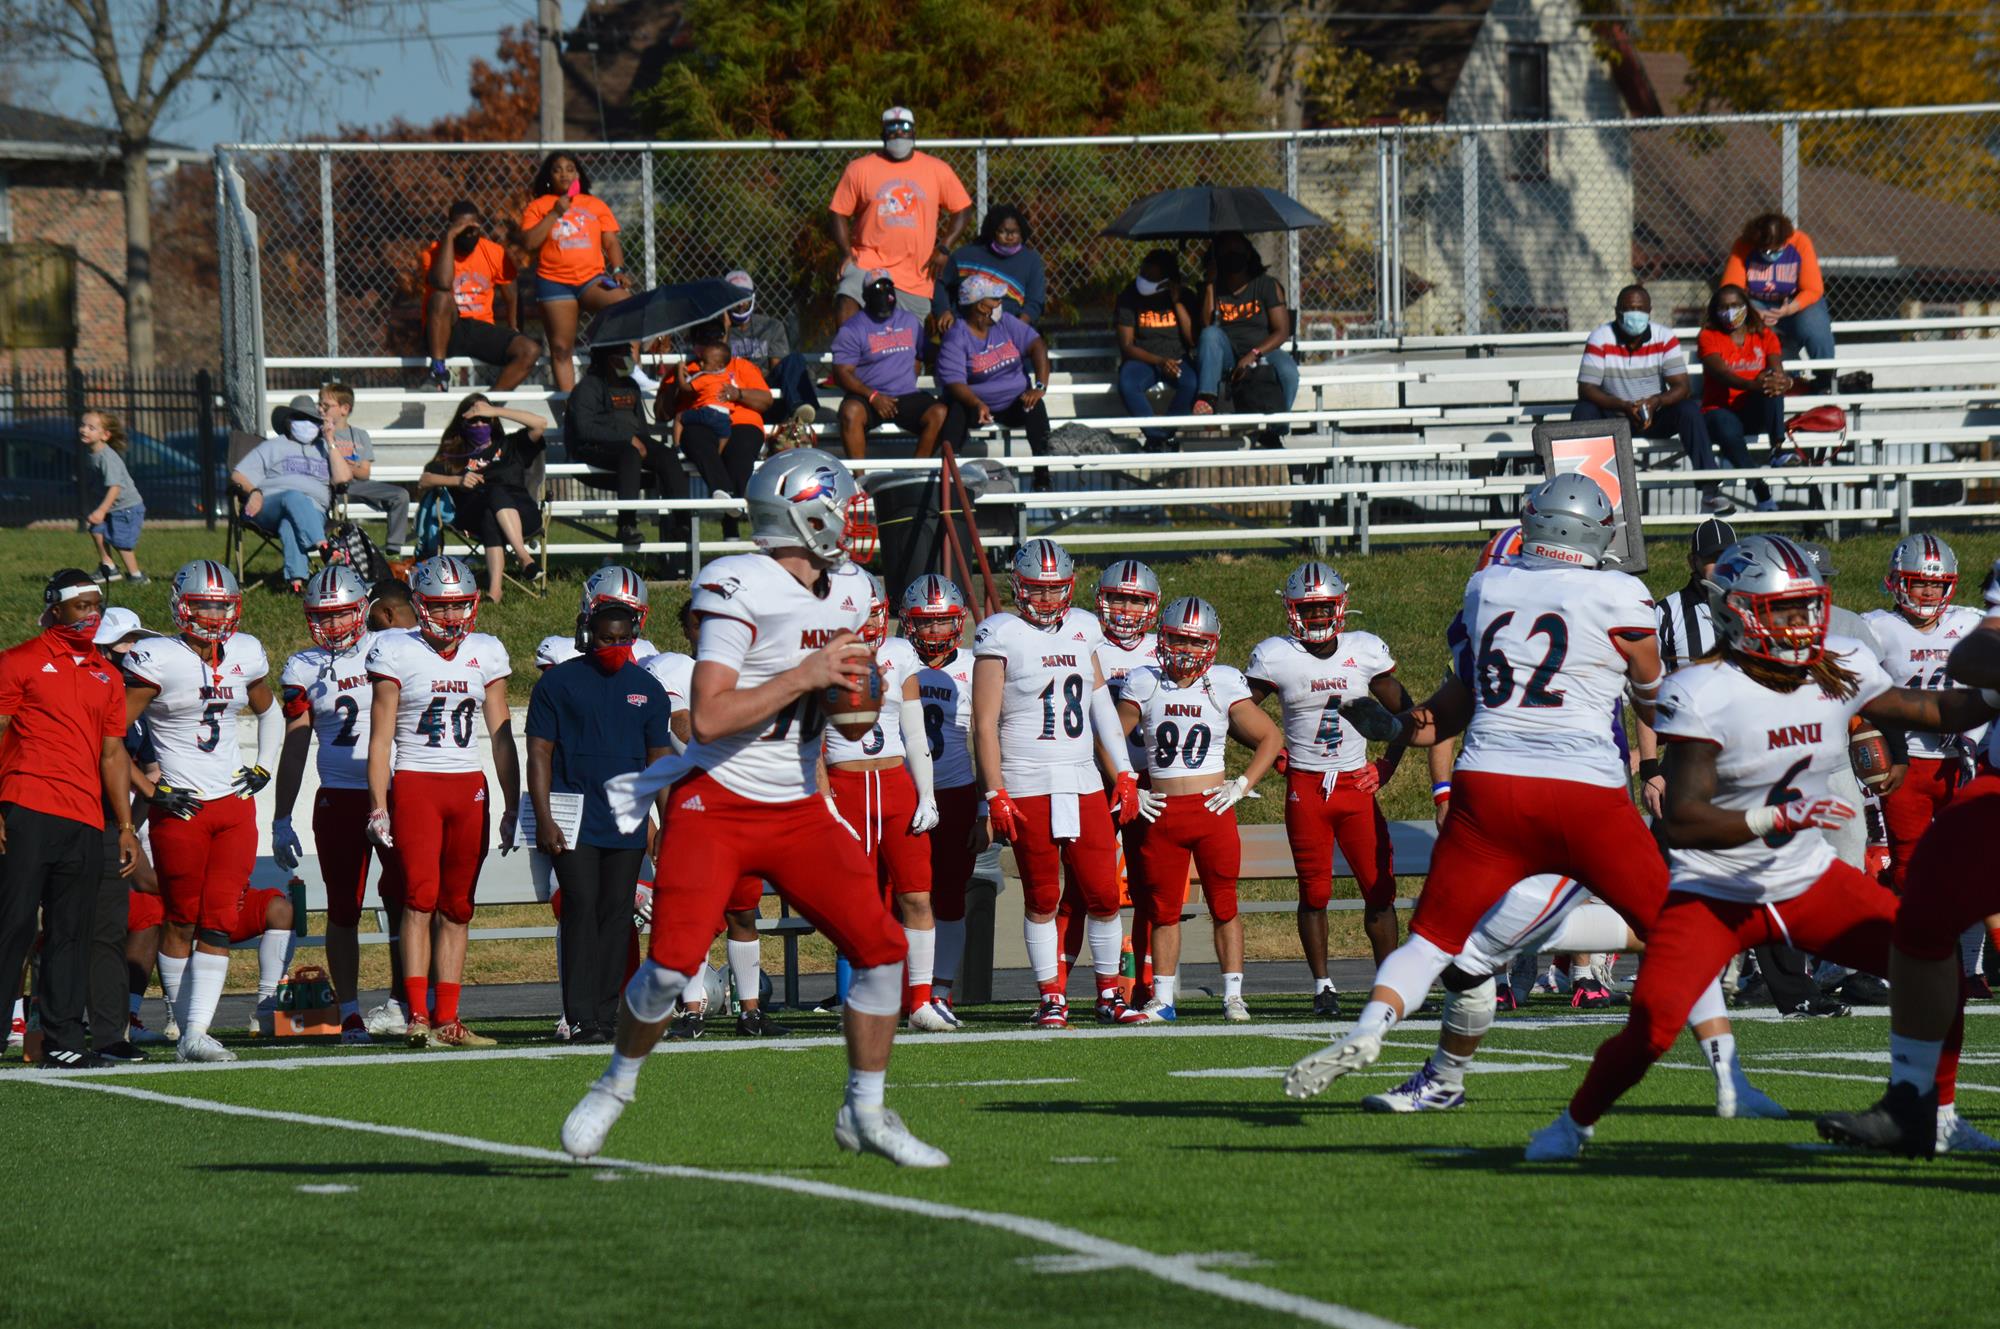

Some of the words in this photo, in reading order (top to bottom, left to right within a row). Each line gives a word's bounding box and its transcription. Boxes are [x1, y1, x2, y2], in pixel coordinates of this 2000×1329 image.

[1535, 545, 1583, 563] Riddell
[800, 628, 837, 650] MN
[1041, 654, 1077, 668] MNU
[1476, 610, 1568, 709] 62
[198, 686, 234, 700] MNU
[431, 680, 469, 693] MNU
[1310, 677, 1348, 692] MNU
[1036, 672, 1084, 740] 18
[1164, 703, 1203, 718] MNU
[197, 702, 228, 752] 5
[331, 695, 361, 747] 2
[416, 696, 477, 749] 40
[1314, 694, 1344, 758] 4
[1155, 720, 1212, 770] 80
[1766, 722, 1823, 751] MNU
